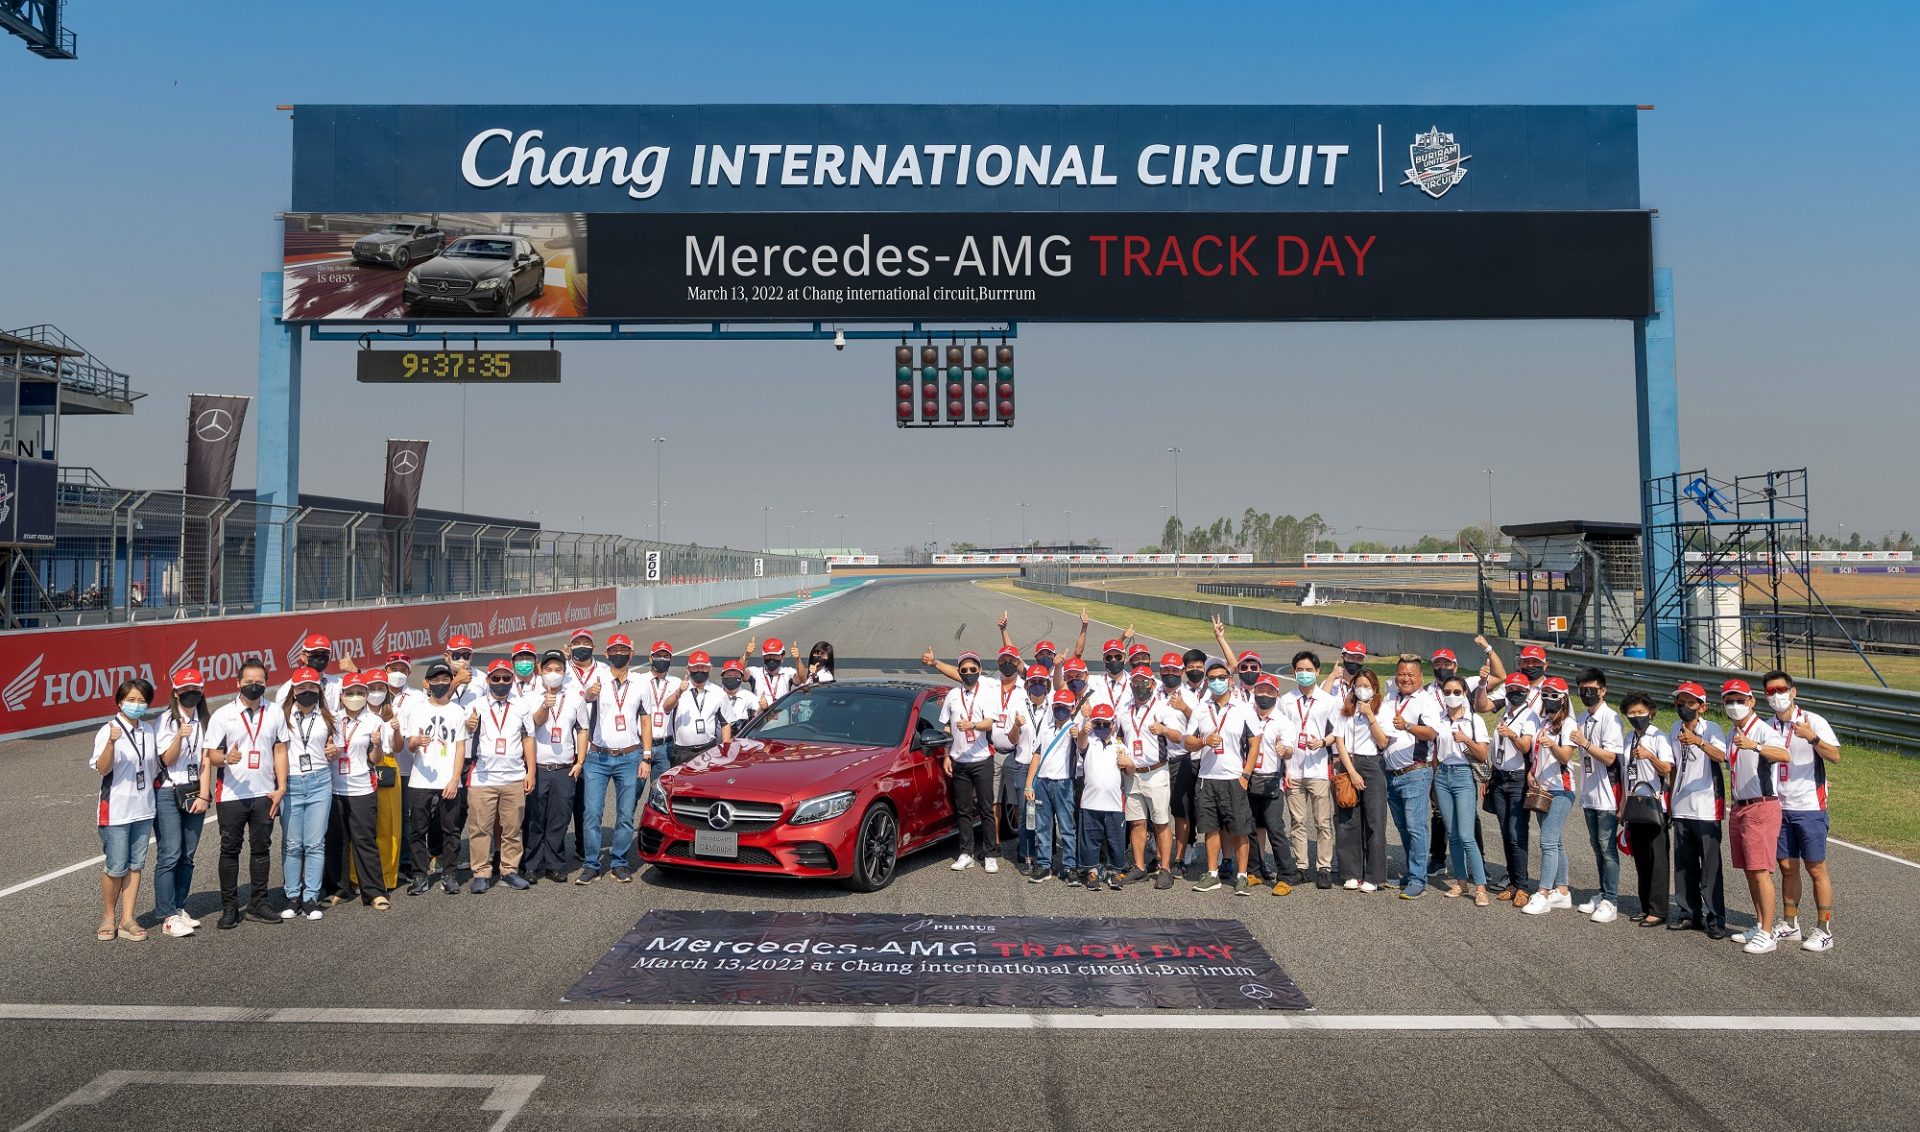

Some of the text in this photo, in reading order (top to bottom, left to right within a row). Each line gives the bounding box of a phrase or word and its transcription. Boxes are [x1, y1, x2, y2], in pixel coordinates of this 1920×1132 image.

[461, 128, 1349, 199] Chang INTERNATIONAL CIRCUIT
[1415, 146, 1457, 164] BURIRAM
[684, 233, 1377, 278] Mercedes-AMG TRACK DAY
[317, 272, 354, 285] is easy
[687, 286, 728, 300] March
[731, 286, 748, 302] 13,
[752, 286, 784, 300] 2022
[787, 287, 800, 300] at
[802, 286, 843, 303] Chang
[846, 286, 930, 300] international
[402, 353, 511, 378] 9:37:35
[648, 553, 657, 579] 200
[497, 616, 526, 633] HONDA
[538, 611, 562, 628] HONDA
[1548, 618, 1555, 630] F
[387, 629, 432, 653] HONDA
[645, 936, 1232, 960] Mercedes-AMG TRACK DAY
[631, 957, 708, 970] March
[811, 961, 834, 971] at
[841, 960, 913, 975] Chang
[921, 960, 1071, 975] international
